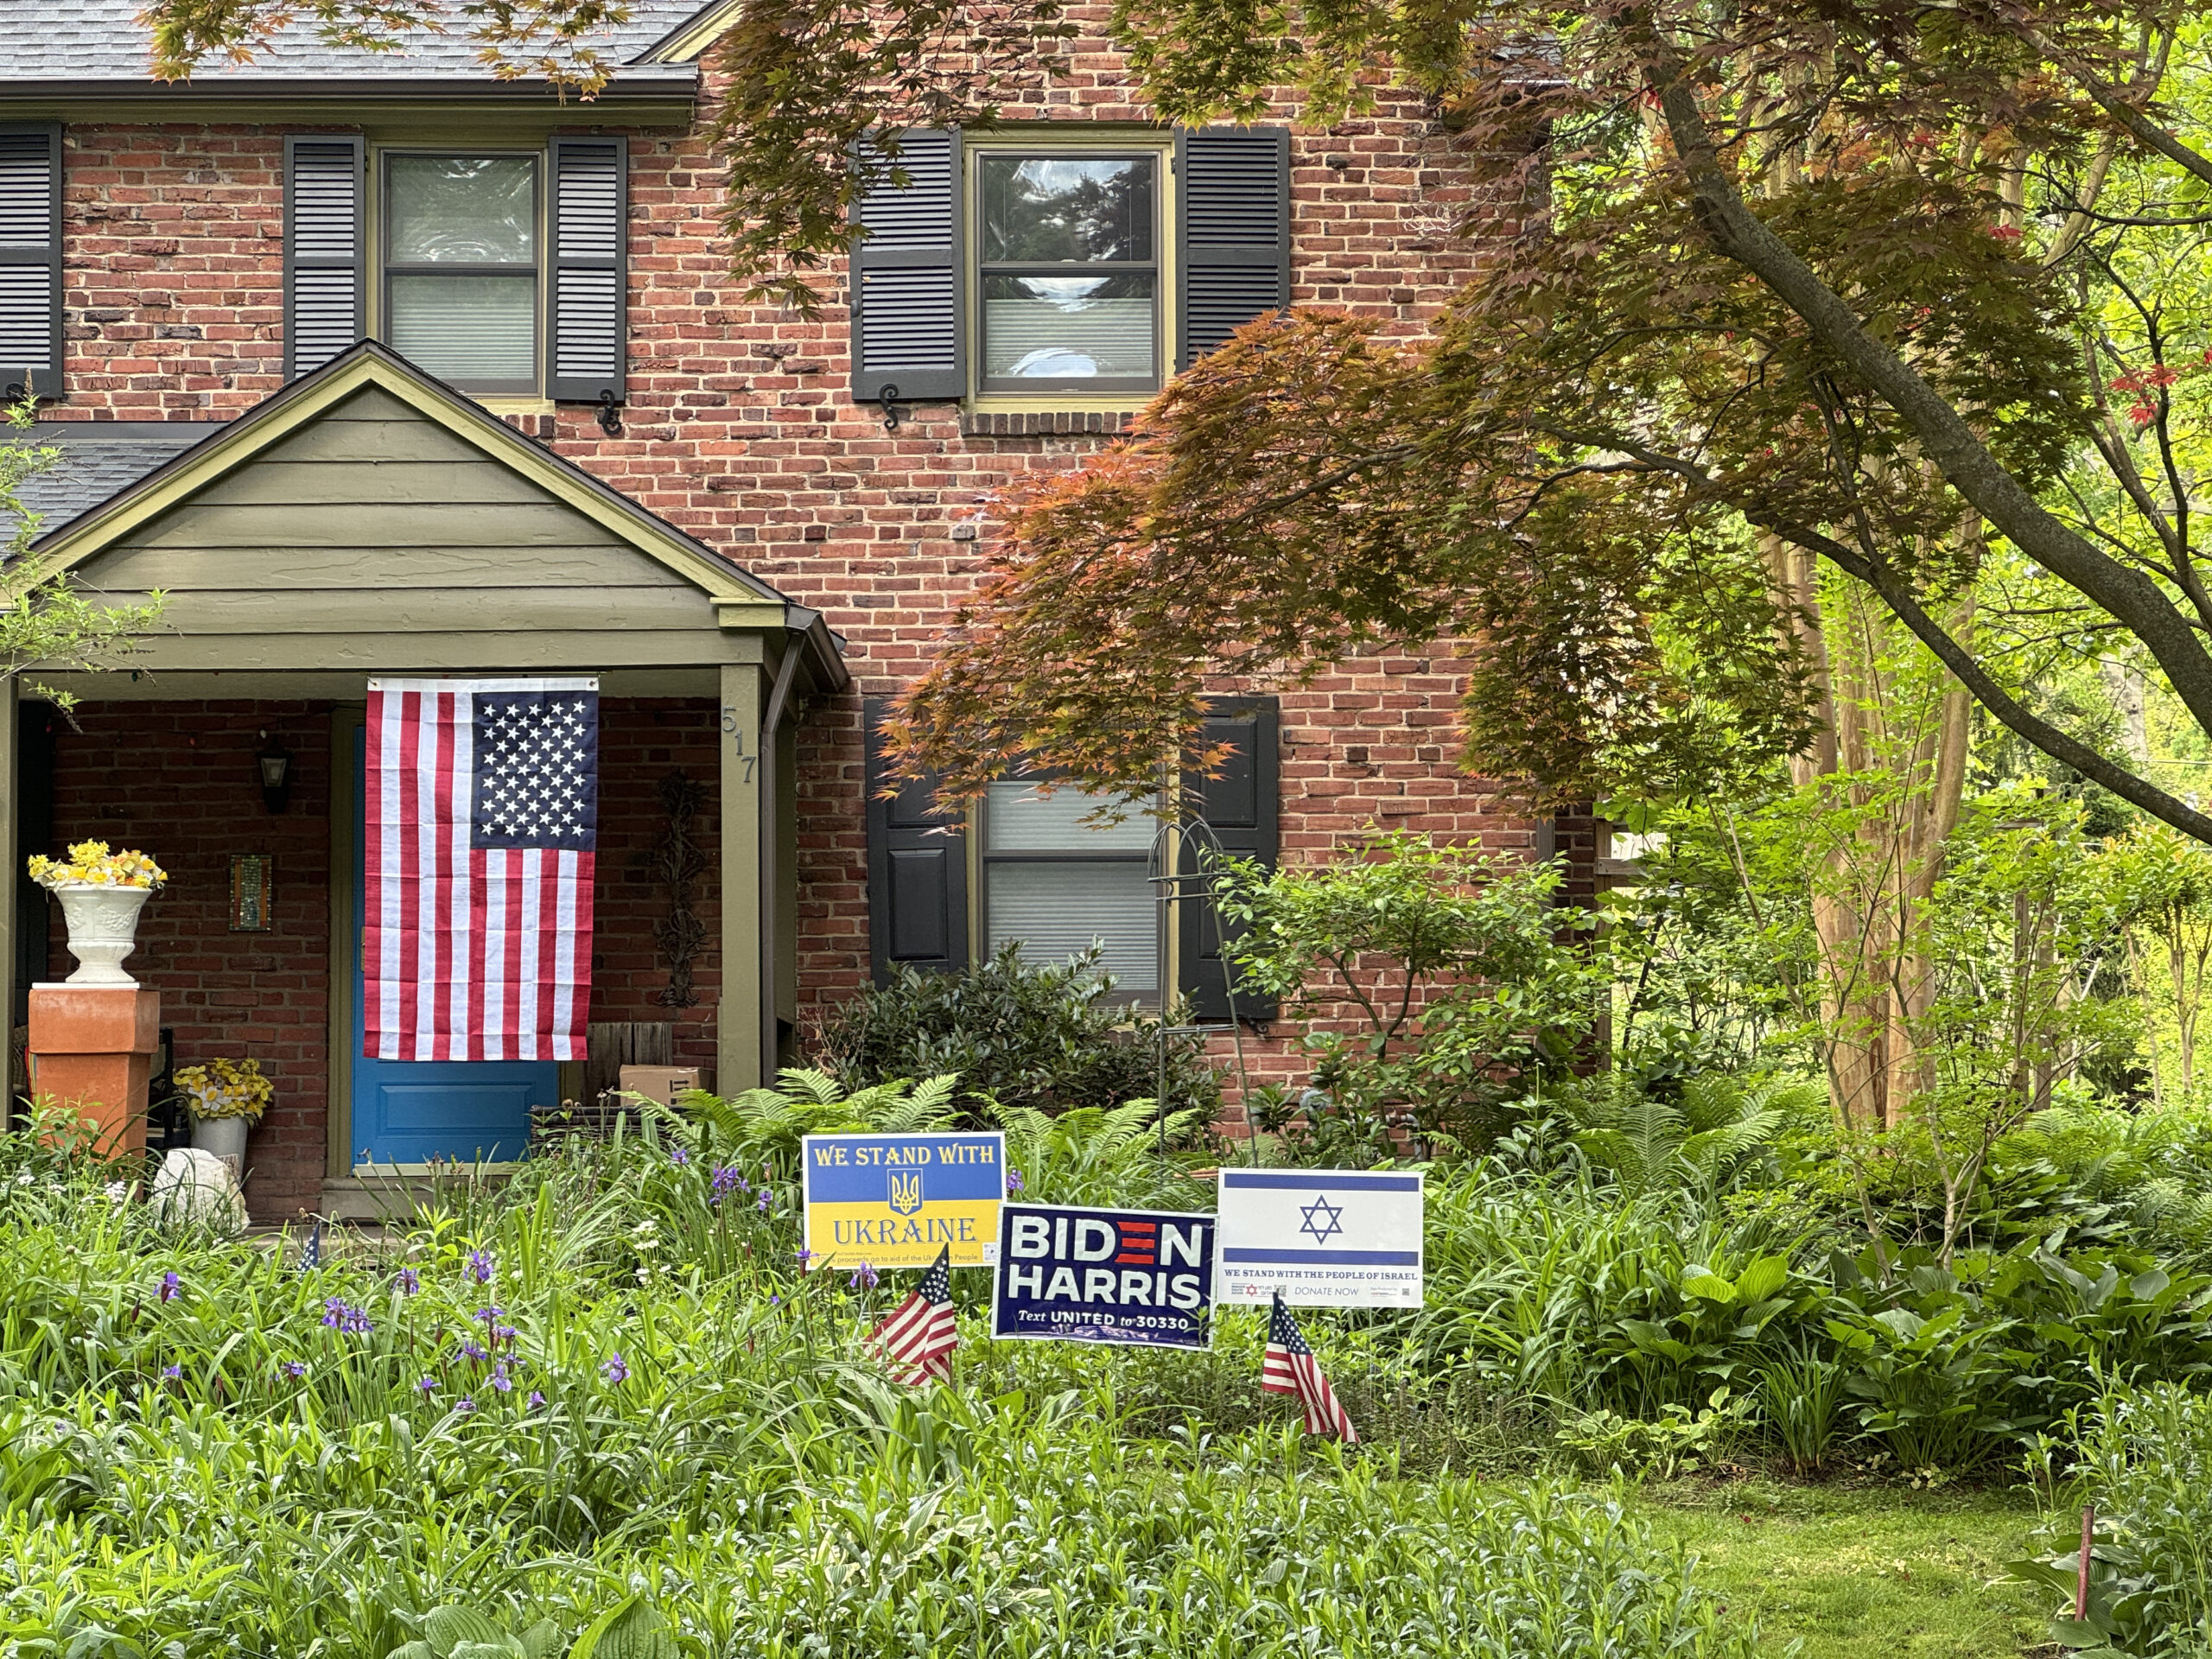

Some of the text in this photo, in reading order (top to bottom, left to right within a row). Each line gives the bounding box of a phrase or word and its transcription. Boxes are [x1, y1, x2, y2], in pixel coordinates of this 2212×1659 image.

[722, 705, 756, 783] 517
[814, 1142, 995, 1166] WE STAND WITH
[833, 1217, 978, 1245] UKRAINE
[1010, 1215, 1203, 1268] BIDEN
[955, 1253, 978, 1262] People
[1007, 1264, 1201, 1309] HARRIS
[1294, 1287, 1359, 1296] DONATE NOW
[1018, 1310, 1189, 1330] Text UNITED to 30330
